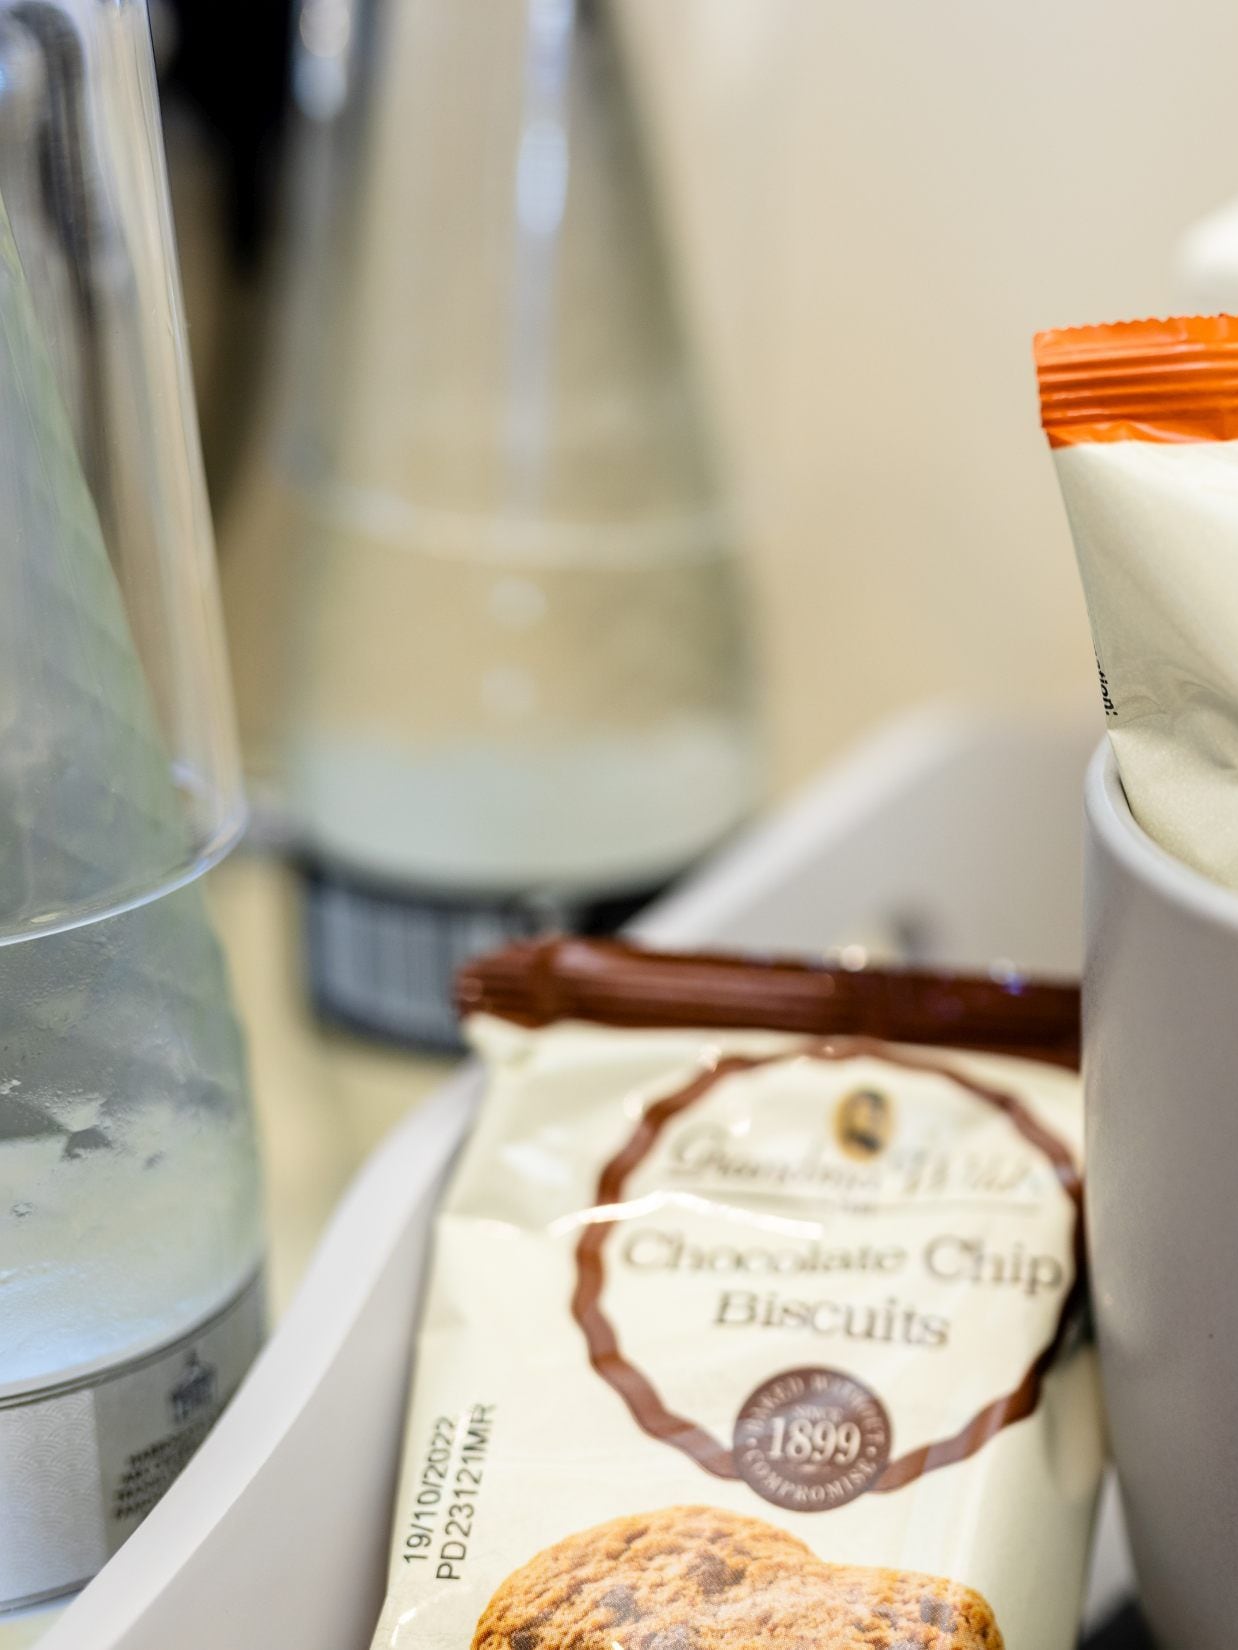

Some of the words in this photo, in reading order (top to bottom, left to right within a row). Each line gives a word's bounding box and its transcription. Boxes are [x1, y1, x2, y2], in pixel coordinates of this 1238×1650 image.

[620, 1228, 904, 1276] Chocolate
[923, 1232, 1064, 1296] Chip
[713, 1288, 950, 1347] Biscuits
[768, 1417, 862, 1466] 1899
[403, 1416, 455, 1563] 19/10/2022
[436, 1403, 496, 1580] PD23121MR
